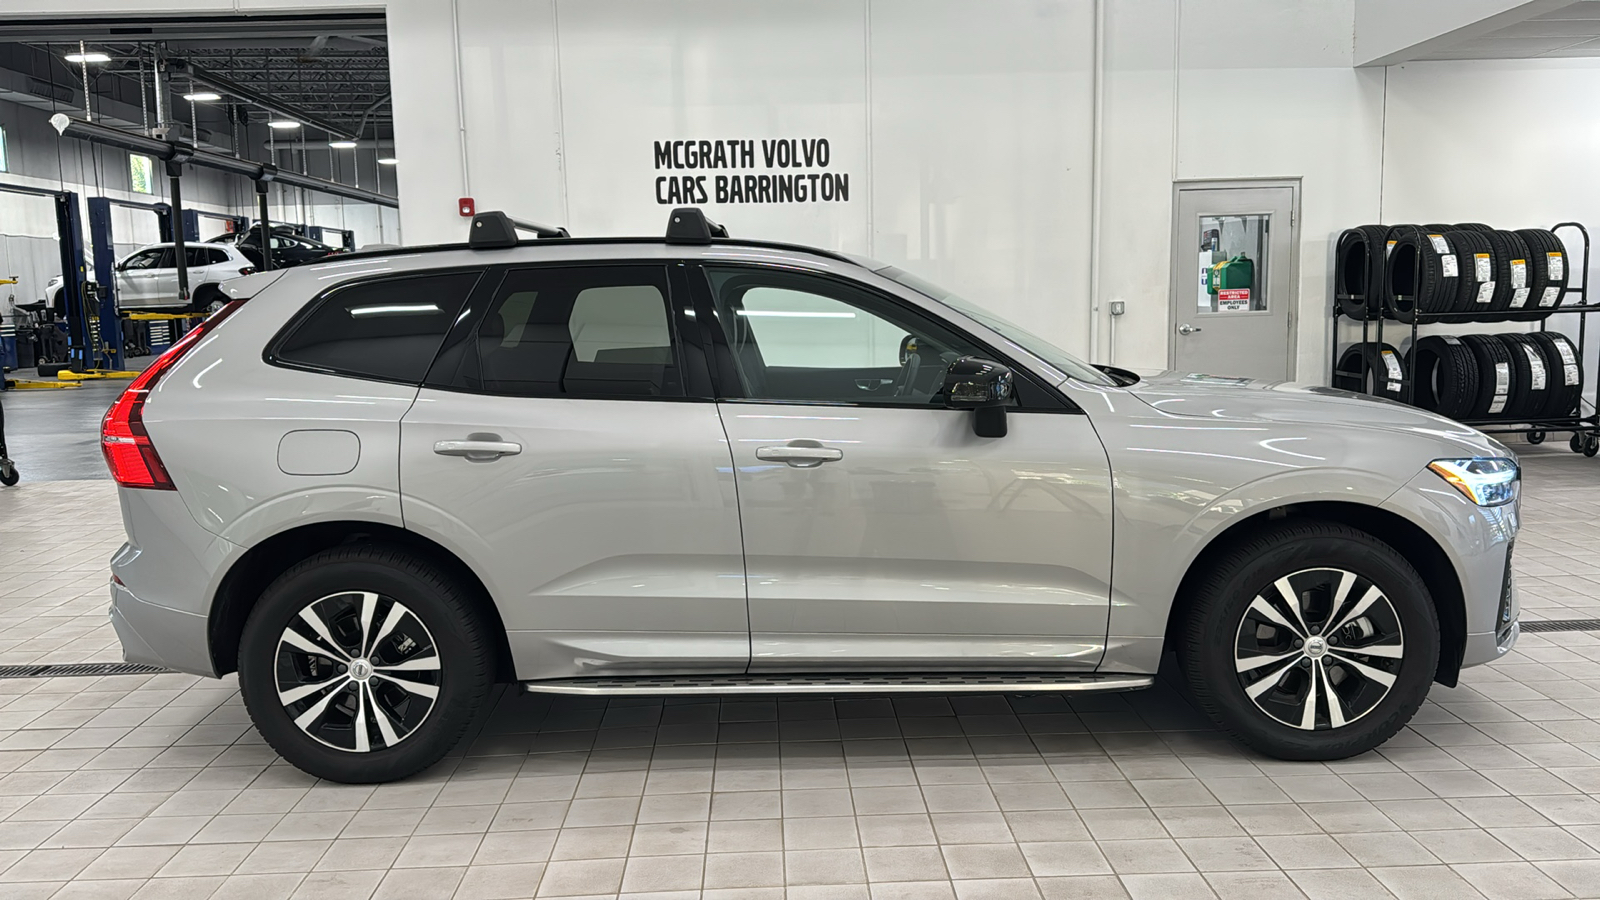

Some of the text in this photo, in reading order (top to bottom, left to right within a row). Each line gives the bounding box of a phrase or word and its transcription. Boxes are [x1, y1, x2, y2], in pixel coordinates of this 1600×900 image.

[654, 138, 830, 169] MCGRATH VOLVO
[655, 173, 849, 204] CARS BARRINGTON
